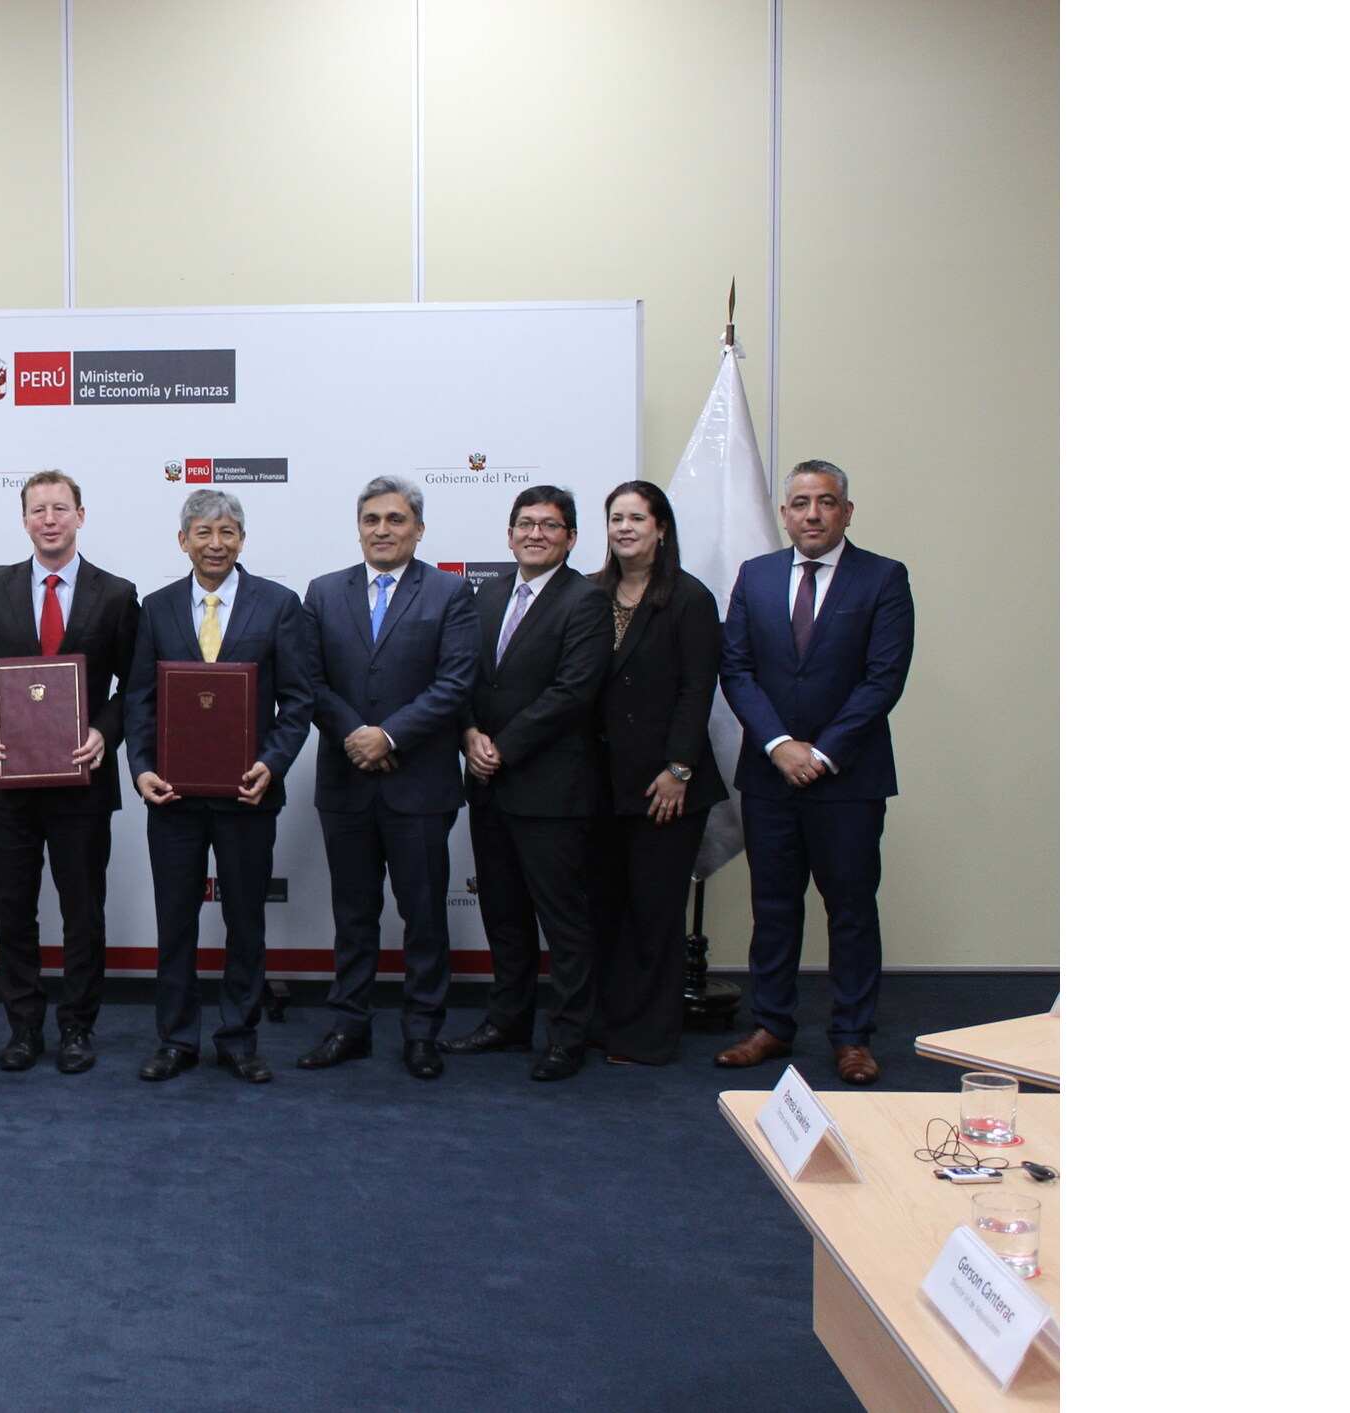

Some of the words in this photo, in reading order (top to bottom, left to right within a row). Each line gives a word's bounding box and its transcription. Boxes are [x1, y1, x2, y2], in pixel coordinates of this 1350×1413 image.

[20, 366, 66, 388] PERÚ
[79, 369, 144, 383] Ministerio
[79, 384, 96, 398] de
[99, 384, 161, 398] Economía
[163, 386, 172, 399] y
[174, 384, 229, 397] Finanzas
[187, 465, 210, 476] PERÚ
[215, 466, 247, 474] Ministerio
[215, 473, 224, 481] de
[224, 473, 254, 481] Economía
[425, 473, 479, 484] Gobierno
[482, 472, 500, 483] del
[504, 472, 530, 483] Perú
[957, 1256, 983, 1290] Gerson
[981, 1281, 1015, 1323] Canterac
